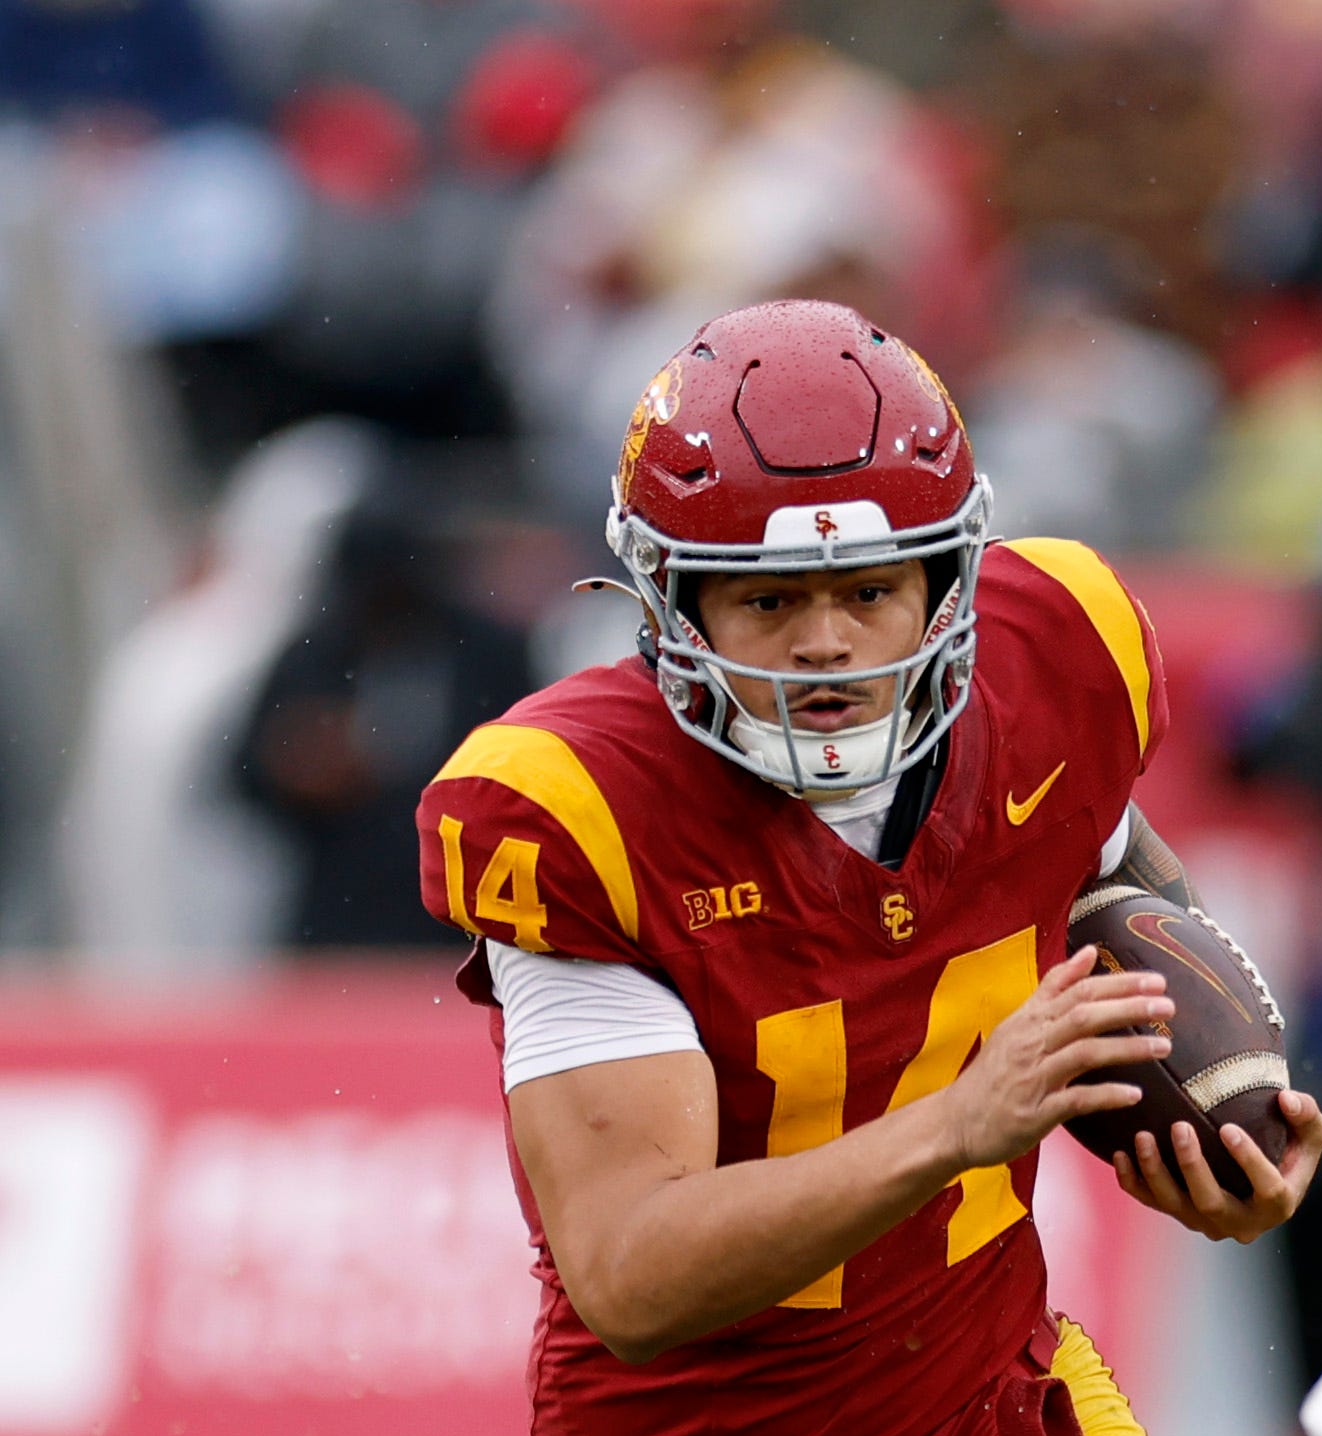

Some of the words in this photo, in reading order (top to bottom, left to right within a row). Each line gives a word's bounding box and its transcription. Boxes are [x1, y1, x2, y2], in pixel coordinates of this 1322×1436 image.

[438, 813, 556, 953] 14
[883, 893, 914, 941] SC
[757, 925, 1038, 1309] 14
